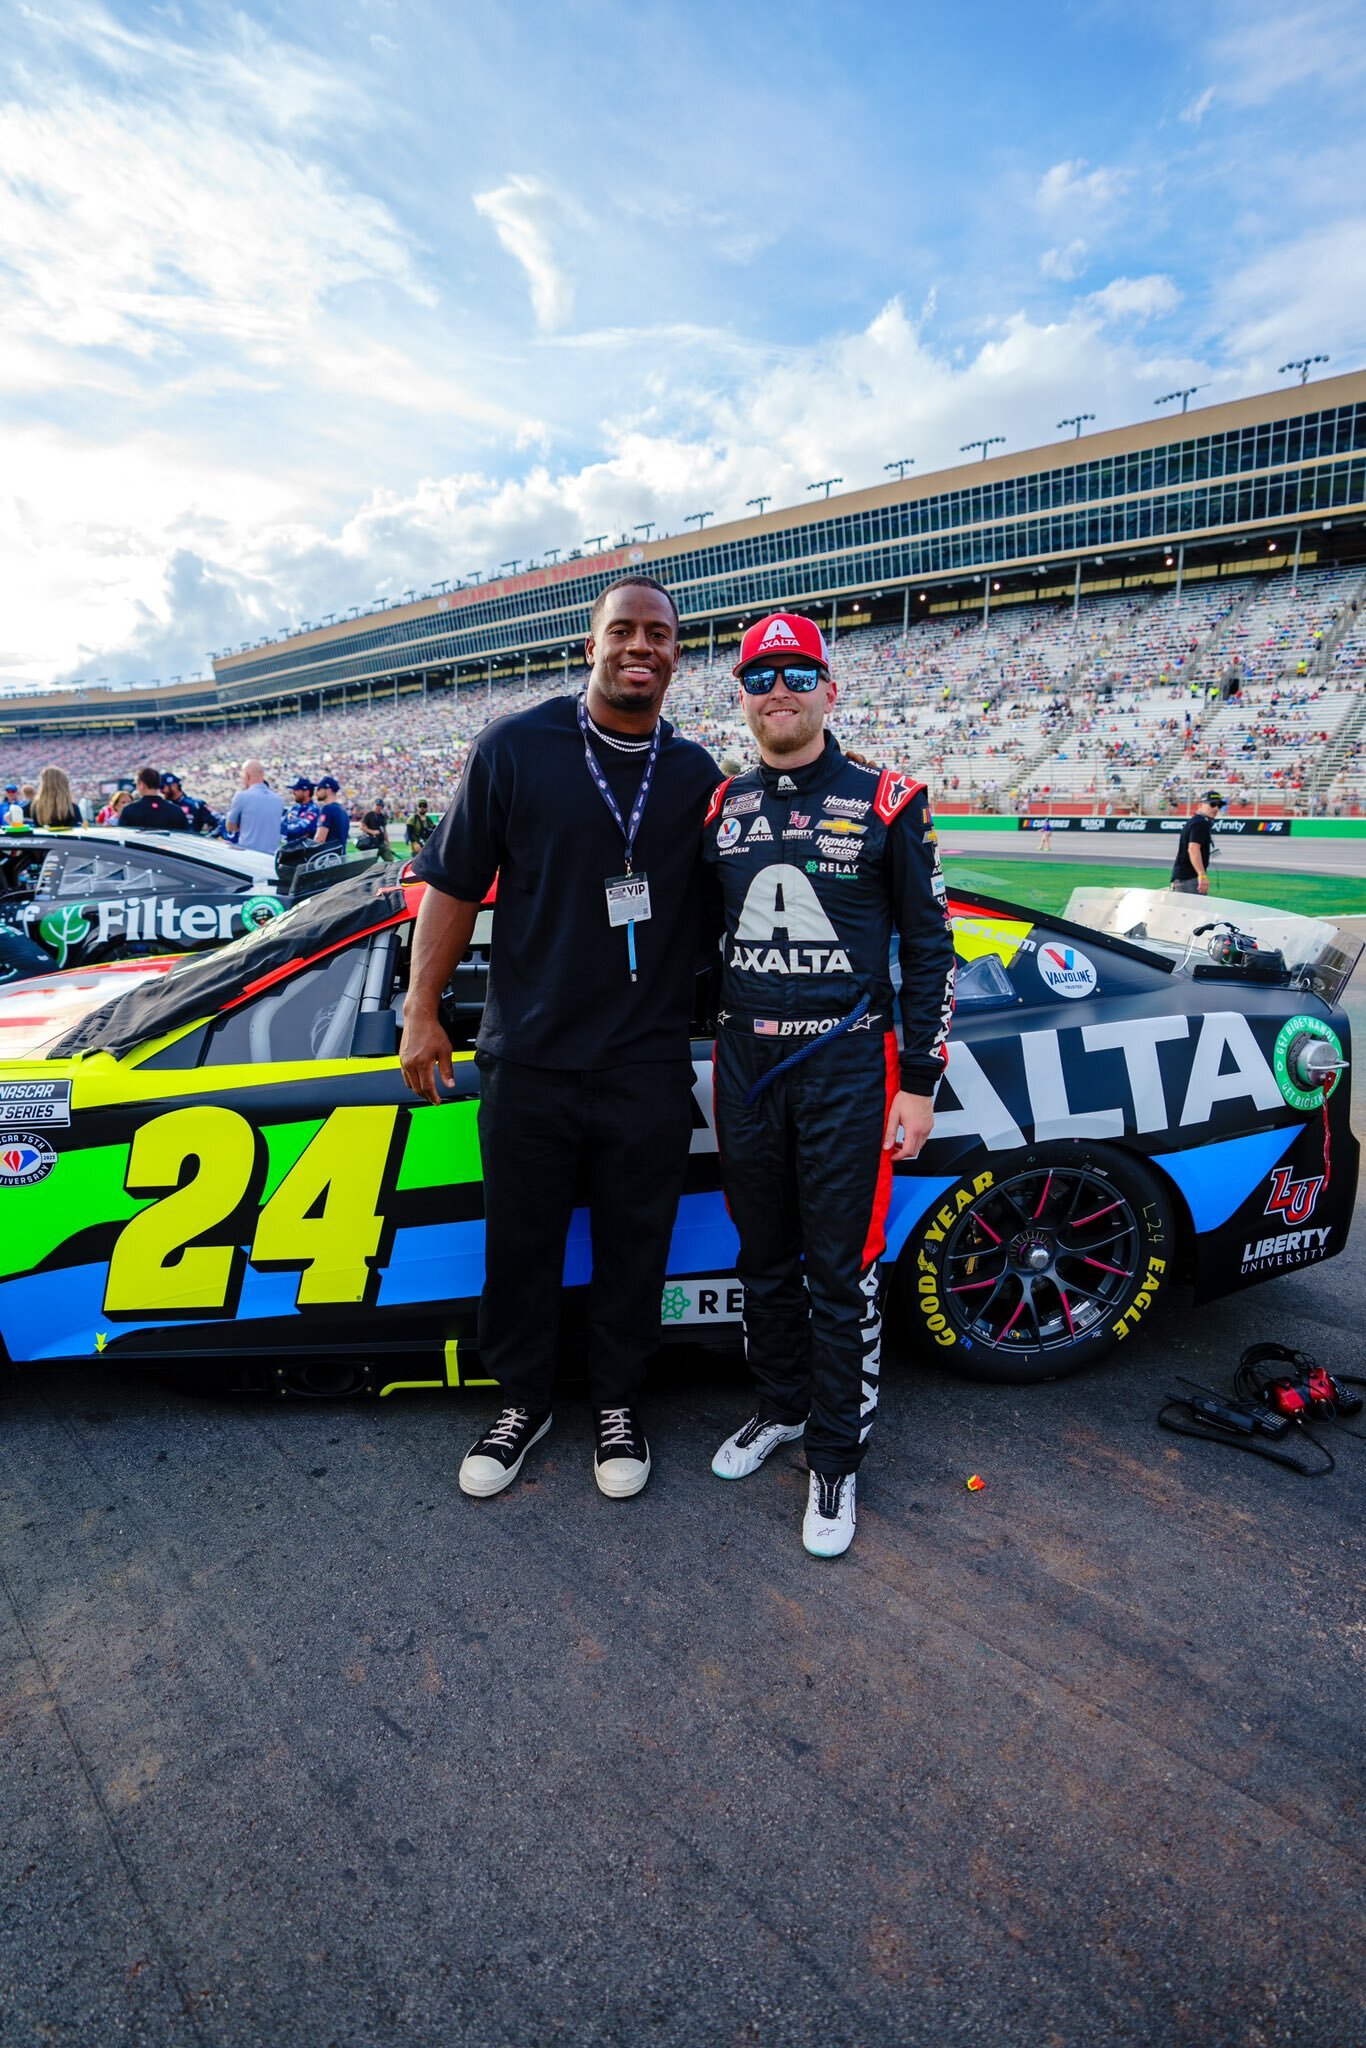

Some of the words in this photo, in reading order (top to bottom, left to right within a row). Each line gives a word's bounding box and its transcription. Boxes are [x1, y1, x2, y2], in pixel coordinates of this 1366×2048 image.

[503, 573, 546, 595] MOTOR
[552, 551, 625, 583] SPEEDWAY
[758, 639, 800, 652] AXALTA
[822, 795, 872, 810] Hendrick
[1160, 821, 1187, 830] GEIC
[744, 833, 774, 843] AXALTA
[815, 835, 865, 850] Hendrick
[819, 862, 860, 874] RELAY
[626, 883, 646, 896] VIP
[95, 896, 245, 943] Filter
[729, 946, 853, 974] AXALTA
[1045, 970, 1093, 986] VALVOLINE
[0, 1084, 55, 1099] NASCAR
[689, 1011, 1287, 1160] ALTA
[1294, 1092, 1326, 1108] BIOETH
[5, 1104, 54, 1119] SERIES
[0, 1134, 19, 1143] CAR
[22, 1134, 46, 1150] 75TH
[0, 1164, 50, 1185] IVERSARY
[103, 1105, 399, 1311] 24
[1242, 1226, 1332, 1262] LIBERTY
[1240, 1247, 1327, 1274] UNIVERSITY
[1112, 1256, 1166, 1341] EAGLE
